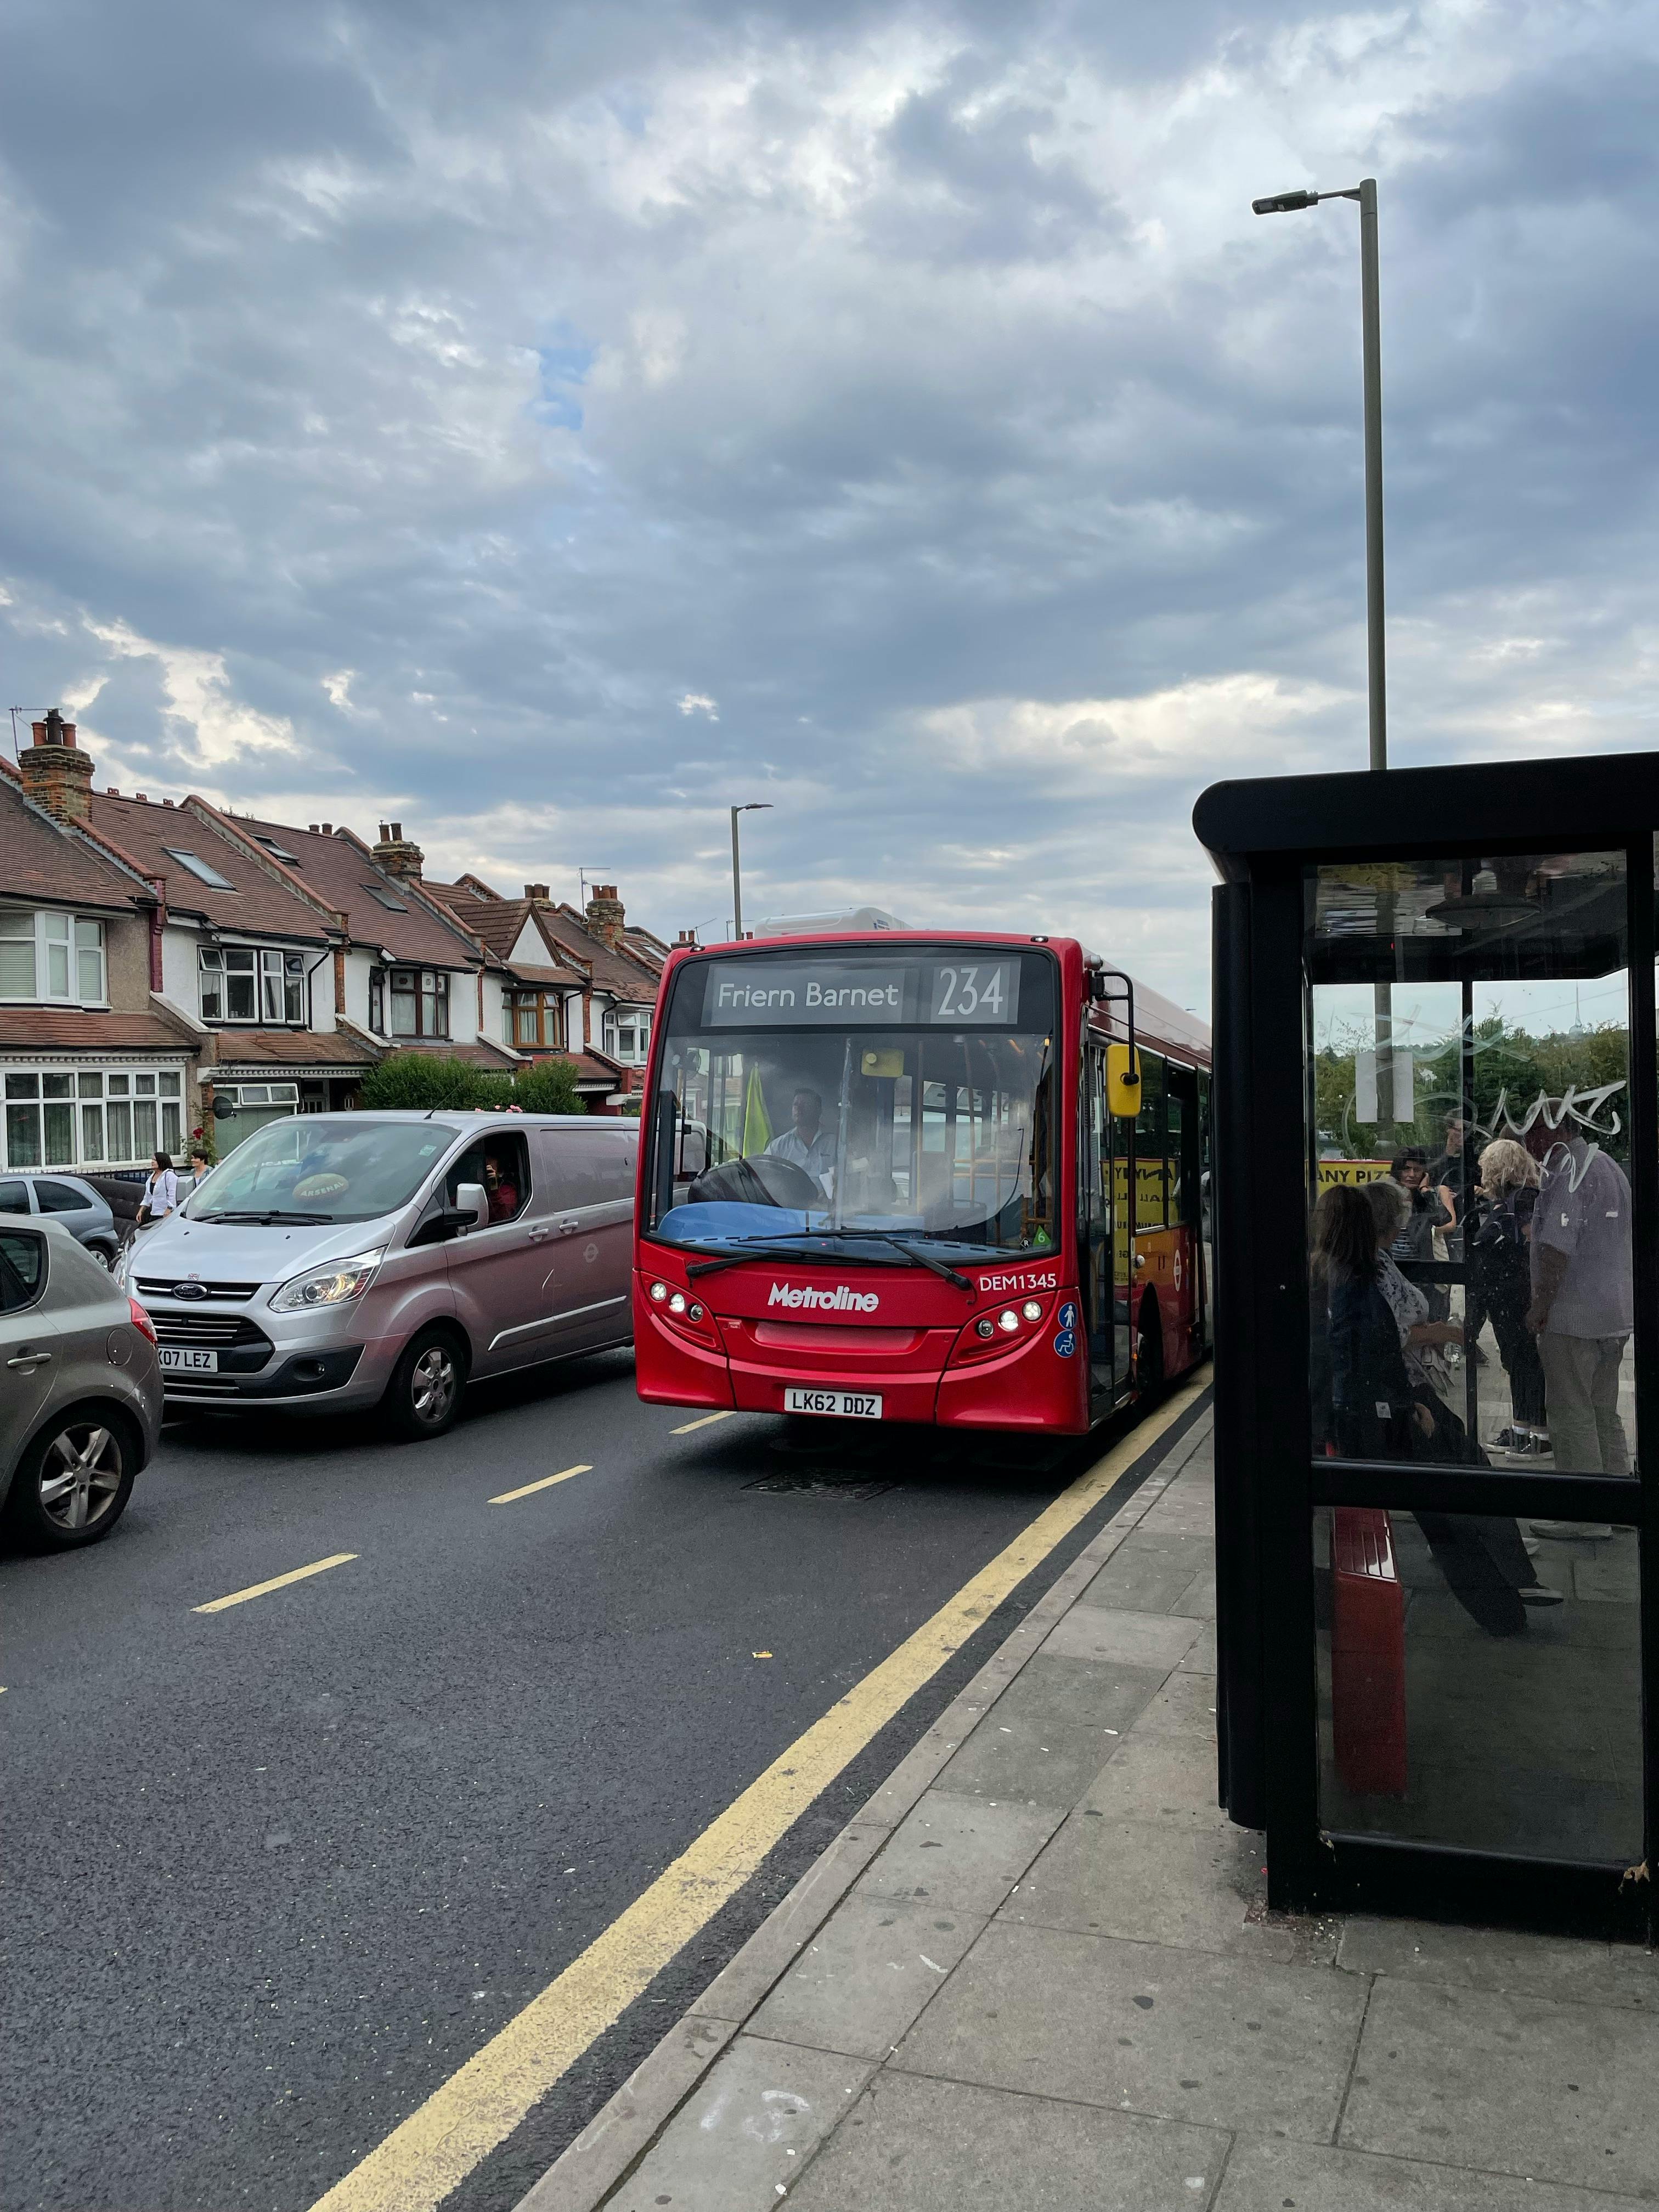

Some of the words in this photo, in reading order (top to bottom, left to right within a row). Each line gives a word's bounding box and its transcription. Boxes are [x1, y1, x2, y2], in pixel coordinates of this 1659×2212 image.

[718, 983, 795, 1008] Friern
[805, 981, 899, 1007] Barnet
[938, 966, 1003, 1015] 234
[1317, 1170, 1350, 1183] ANY
[299, 1182, 344, 1197] ARSENAL
[1038, 1232, 1045, 1243] 6
[979, 1273, 1057, 1291] DEM1345
[768, 1282, 879, 1312] Metroline
[184, 1352, 211, 1368] LEZ
[792, 1392, 836, 1412] LK62
[843, 1396, 876, 1416] DDZ
